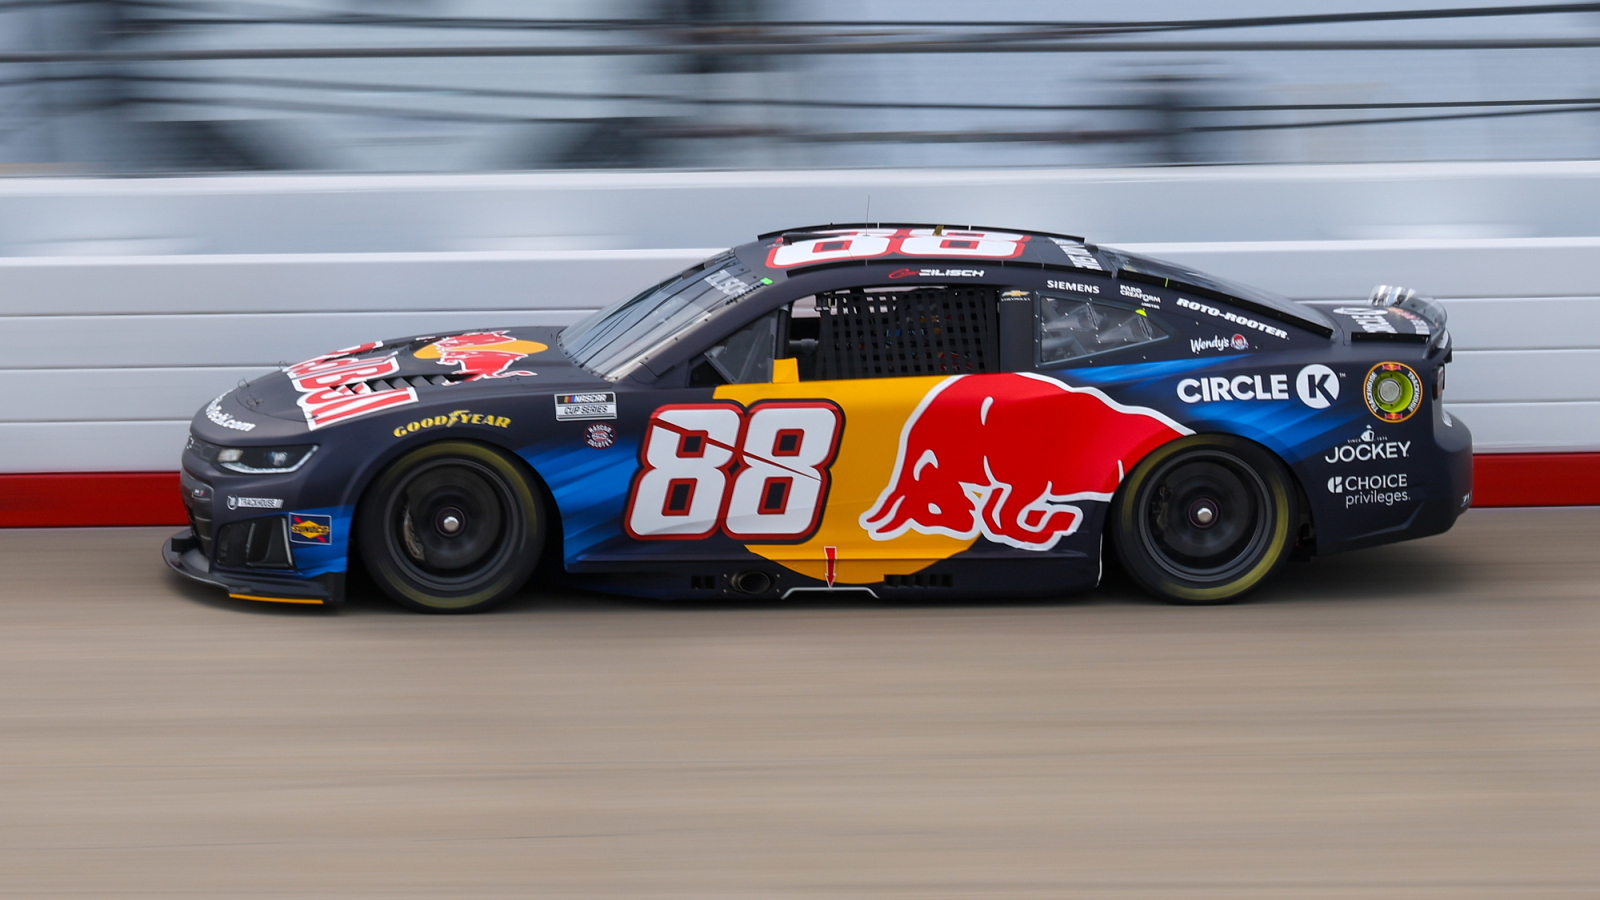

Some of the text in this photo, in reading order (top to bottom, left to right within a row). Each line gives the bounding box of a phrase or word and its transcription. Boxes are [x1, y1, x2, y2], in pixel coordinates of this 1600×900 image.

[765, 228, 1032, 269] 88
[919, 269, 985, 277] ZILISCH
[1046, 279, 1101, 294] SIEMENS
[1176, 297, 1288, 340] ROTO-ROOTER
[1190, 335, 1230, 353] Wendy's
[1176, 374, 1290, 404] CIRCLE
[393, 410, 512, 438] GOODYEAR
[1324, 440, 1411, 464] JOCKEY
[624, 401, 844, 541] 88
[1345, 473, 1408, 491] CHOICE
[291, 523, 330, 536] SUNOCO
